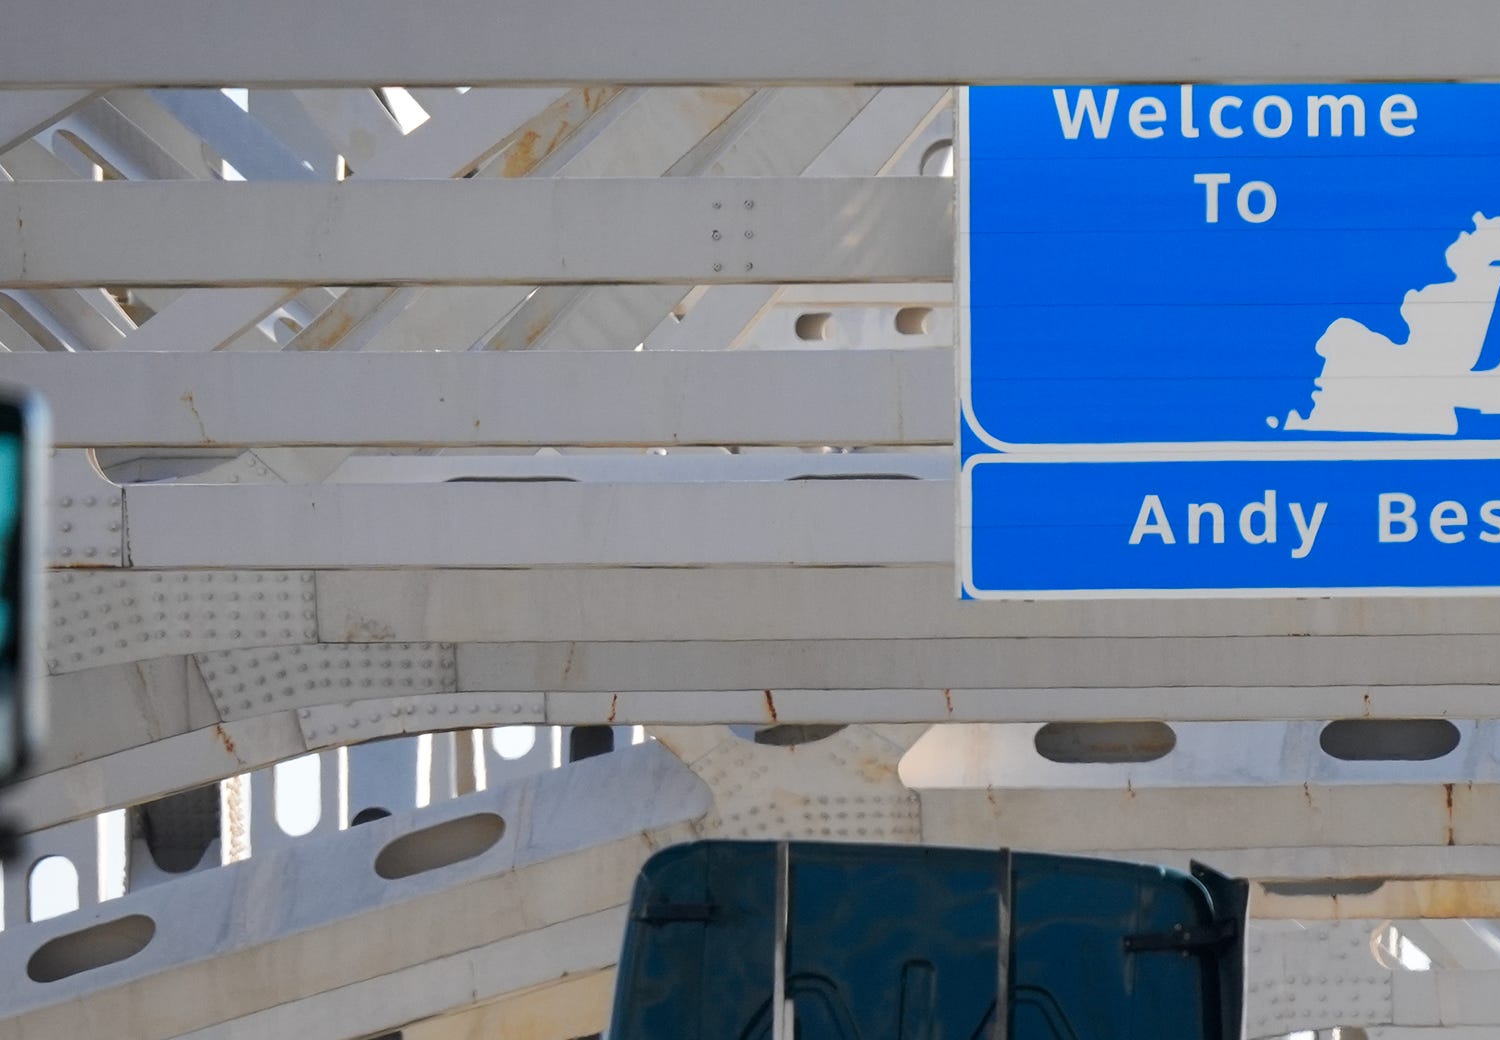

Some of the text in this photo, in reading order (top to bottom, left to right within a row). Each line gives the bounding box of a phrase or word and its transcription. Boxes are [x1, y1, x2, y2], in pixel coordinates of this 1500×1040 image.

[1053, 84, 1417, 140] Welcome
[1194, 173, 1277, 224] To
[1129, 489, 1328, 559] Andy
